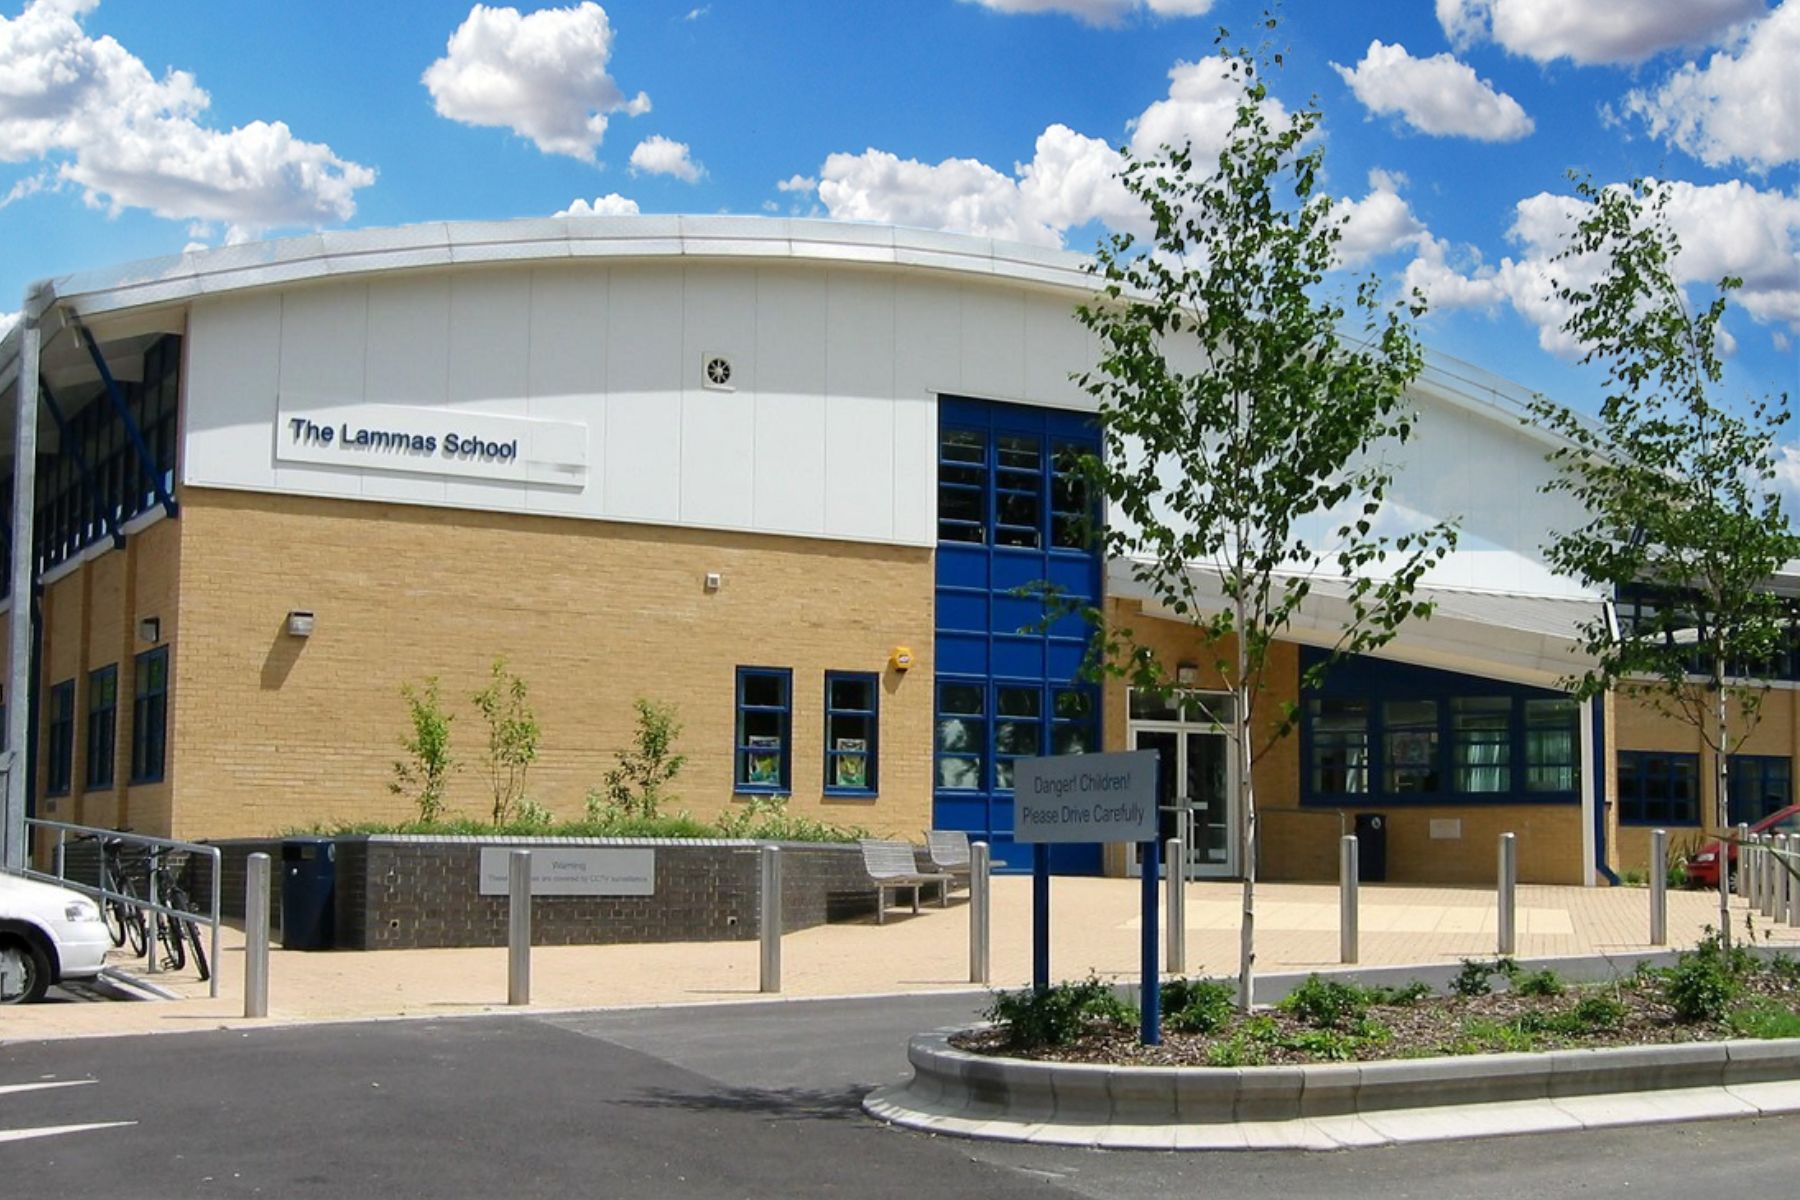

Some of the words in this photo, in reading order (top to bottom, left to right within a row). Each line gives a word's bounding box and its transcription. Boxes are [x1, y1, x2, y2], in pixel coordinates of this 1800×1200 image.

[291, 418, 334, 441] The
[342, 423, 437, 451] Lammas
[443, 433, 517, 459] School
[1034, 775, 1077, 797] Danger!
[1080, 773, 1131, 792] Children!
[1023, 806, 1059, 824] Please
[1061, 805, 1090, 824] Drive
[1093, 803, 1144, 825] Carefully
[552, 861, 586, 871] Warning
